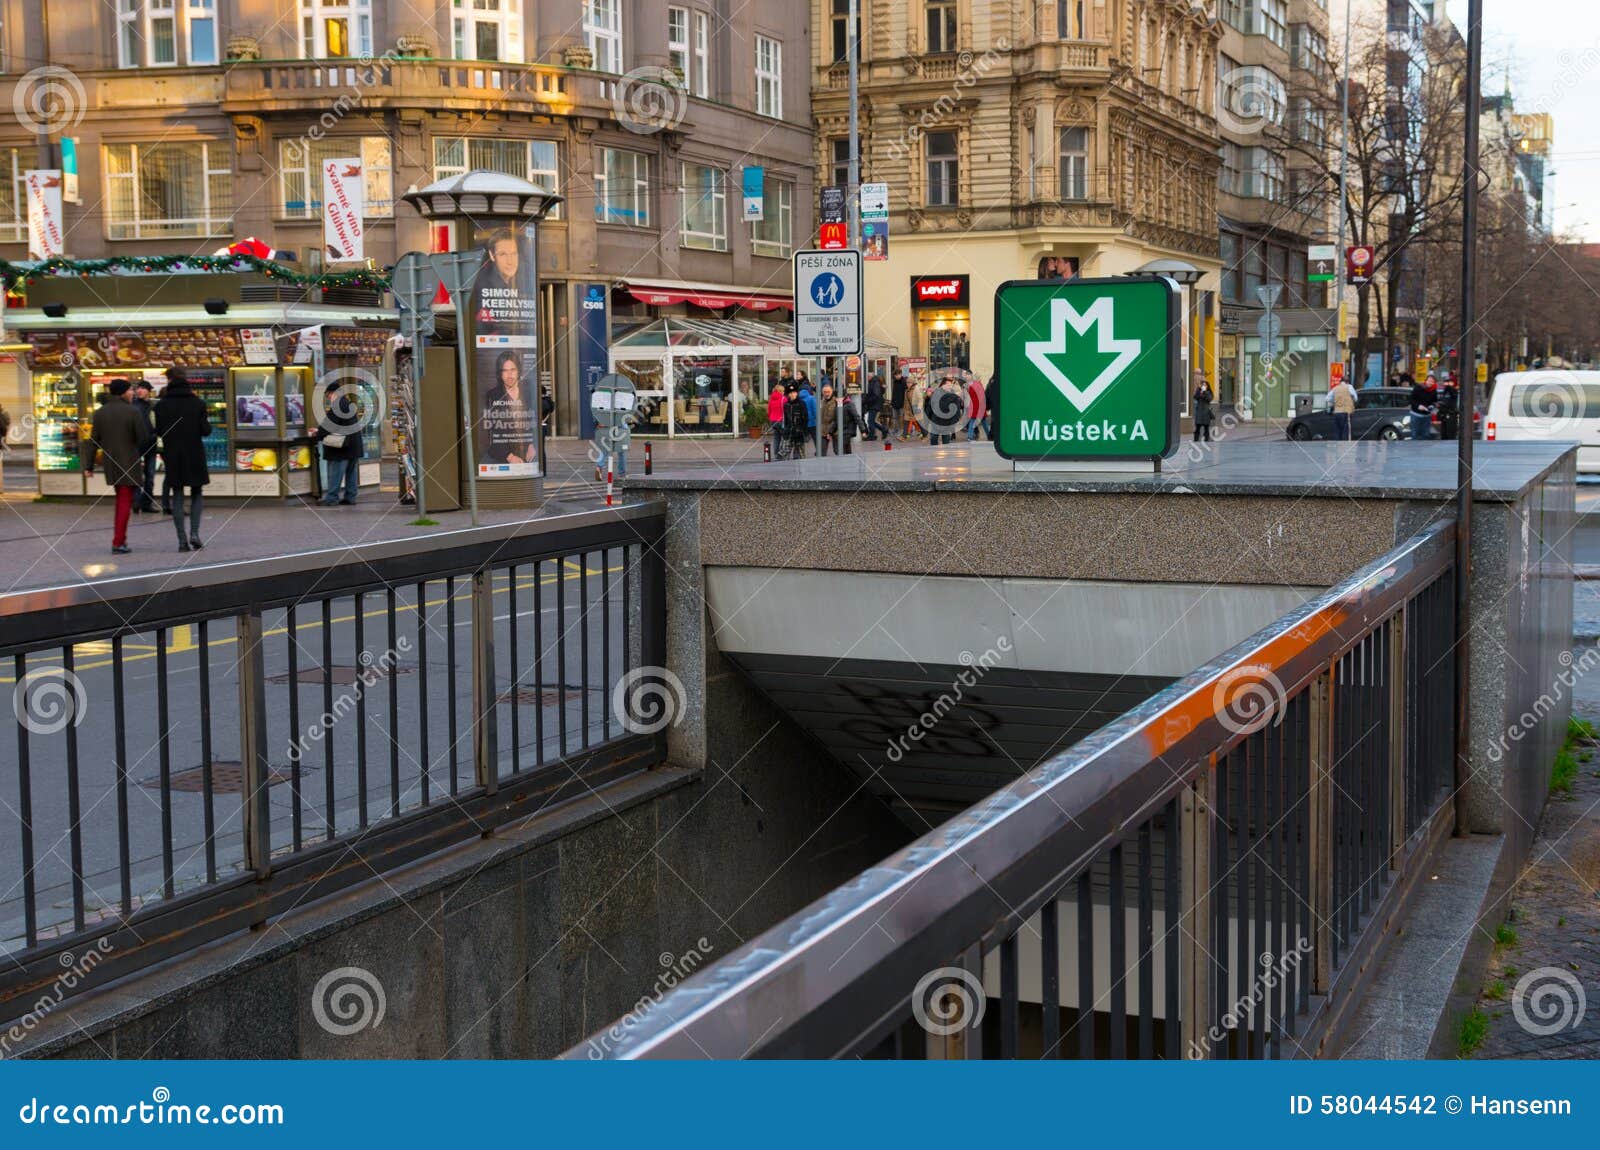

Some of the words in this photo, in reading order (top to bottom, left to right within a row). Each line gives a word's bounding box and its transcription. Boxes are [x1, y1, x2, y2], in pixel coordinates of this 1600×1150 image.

[801, 256, 823, 268] PĚŠÍ
[826, 255, 853, 268] ZÓNA
[481, 288, 518, 298] SIMON
